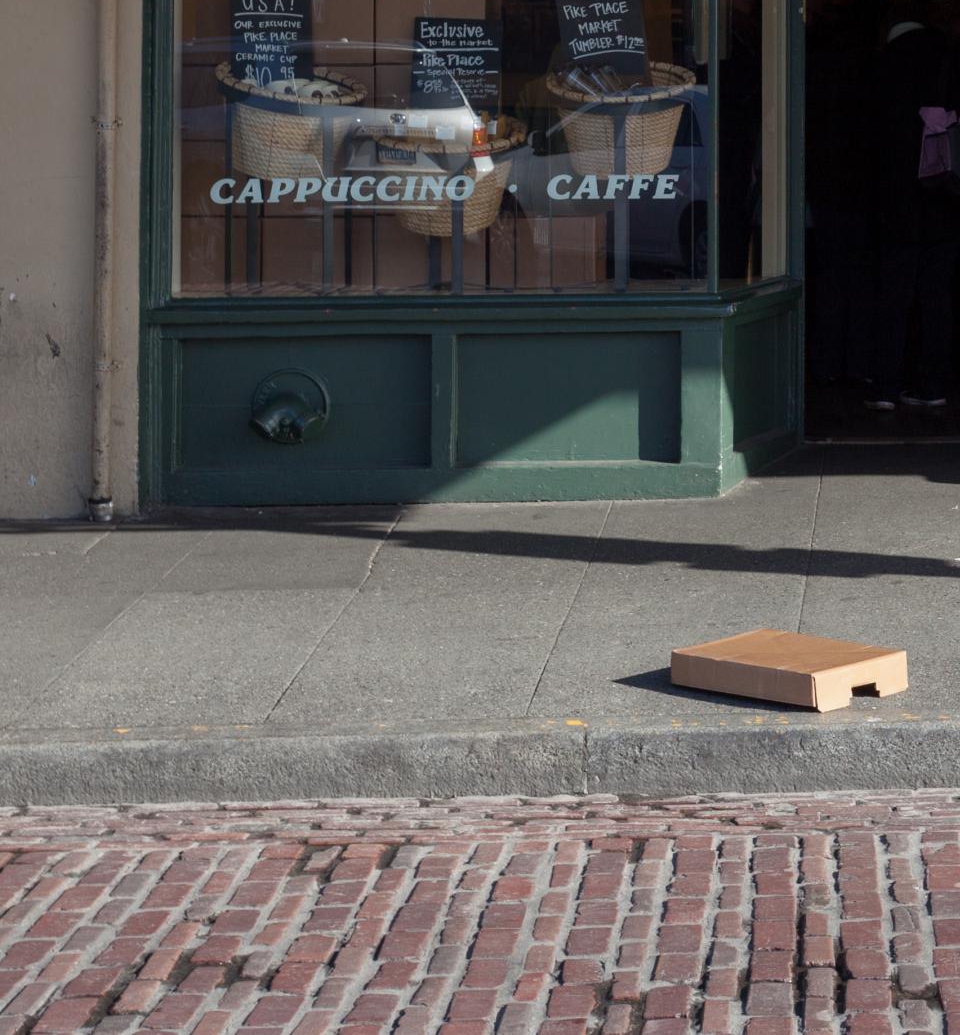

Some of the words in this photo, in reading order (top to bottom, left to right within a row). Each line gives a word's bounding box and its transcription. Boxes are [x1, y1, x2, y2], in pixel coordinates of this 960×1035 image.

[563, 4, 589, 20] PIKE
[588, 1, 630, 17] PLACE
[234, 20, 254, 30] OUR
[578, 18, 622, 36] MARKET
[244, 31, 267, 44] PIKE
[270, 31, 299, 43] PLACE
[255, 43, 289, 54] MARKET
[568, 37, 615, 55] TUMBLER
[235, 52, 275, 62] CERAMIC
[279, 54, 299, 64] CUP
[447, 53, 485, 66] Place
[210, 175, 475, 204] CAPPUCCINO
[546, 173, 680, 200] CAFFE
